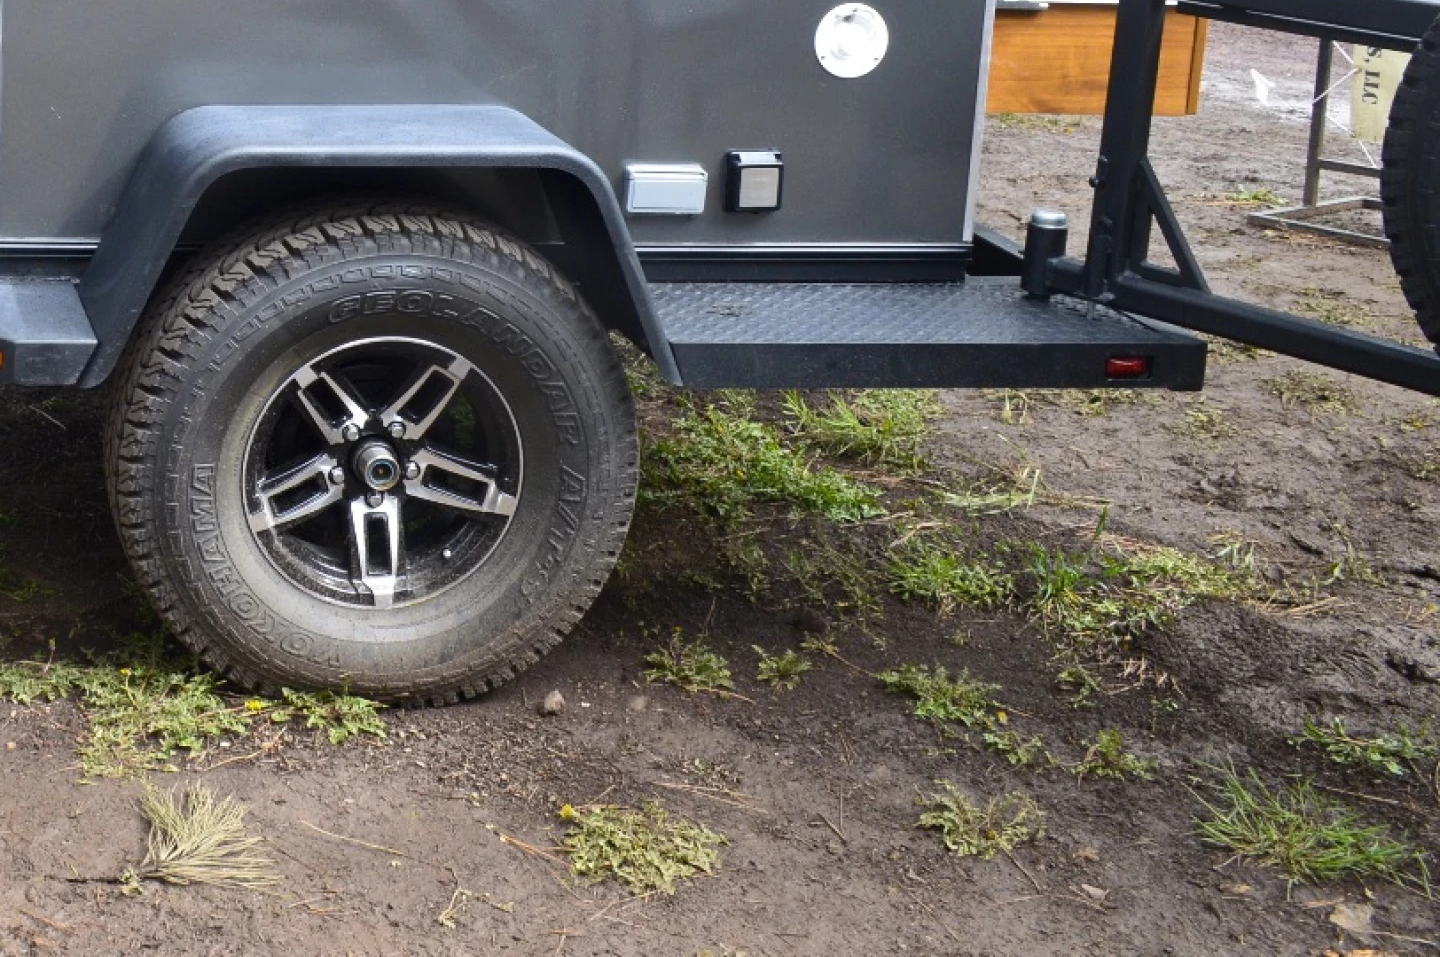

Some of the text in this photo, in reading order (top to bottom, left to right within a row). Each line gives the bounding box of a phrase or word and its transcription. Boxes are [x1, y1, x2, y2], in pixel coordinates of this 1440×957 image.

[1362, 70, 1380, 104] LLC
[328, 290, 585, 446] GEOLANDAR
[192, 463, 342, 669] YOKOHAMA
